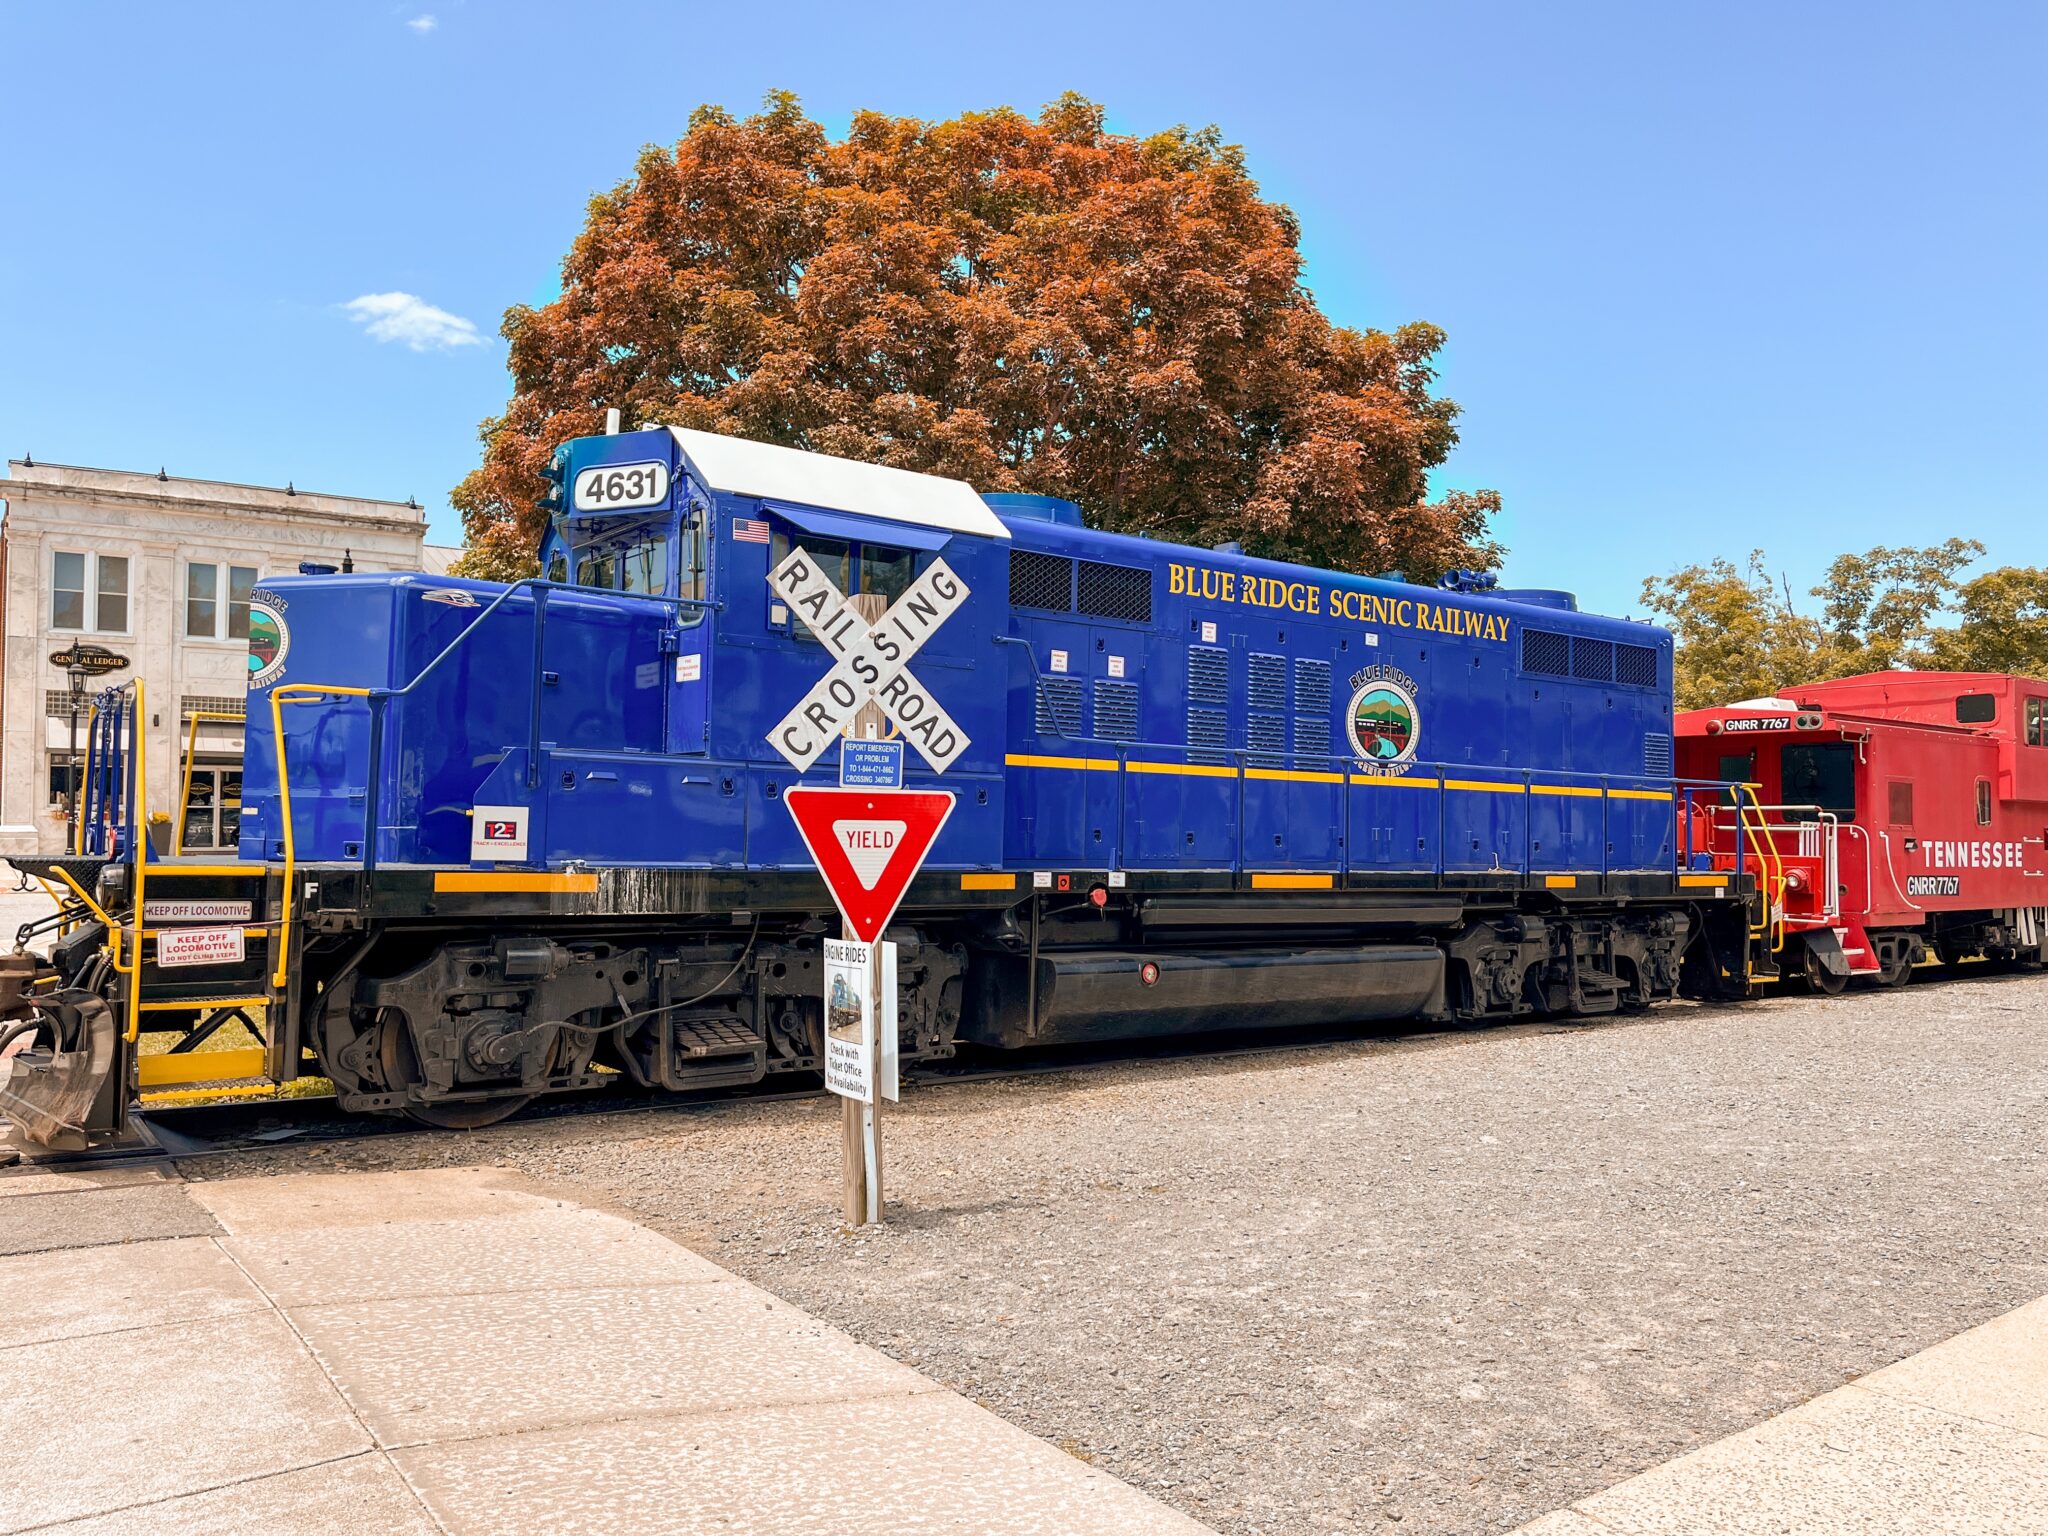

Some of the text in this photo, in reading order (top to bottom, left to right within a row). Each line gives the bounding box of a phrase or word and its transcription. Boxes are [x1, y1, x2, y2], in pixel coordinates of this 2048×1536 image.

[585, 467, 657, 503] 4631
[250, 588, 289, 614] RIDGE
[1168, 562, 1510, 642] BLUE RIDGE SCENIC RAILWAY
[55, 655, 123, 666] GENAL LEDGER
[778, 558, 956, 758] RAIL ROAD
[782, 571, 958, 756] CROSSING
[1350, 664, 1418, 698] BLUE RIDGE
[1725, 718, 1789, 731] GNRR 7767
[845, 743, 899, 753] REPORT EMERGENCY
[855, 754, 889, 763] OR PROBLEM
[849, 764, 857, 772] TO
[845, 774, 873, 783] CROSSING
[846, 830, 894, 849] YIELD
[1921, 840, 2023, 868] TENNESSEE
[304, 882, 319, 899] F
[1907, 876, 1959, 896] GNRR 7767
[148, 905, 248, 916] KEEP OFF LOCOMOTIVE
[166, 942, 236, 953] LOCOMOTIVE
[177, 933, 228, 944] KEEP OFF
[216, 951, 237, 959] STEPS
[825, 943, 867, 964] ENGINE RIDES
[830, 1042, 859, 1060] Check with
[829, 1057, 862, 1078] Ticket Office
[833, 1075, 867, 1097] Availability
